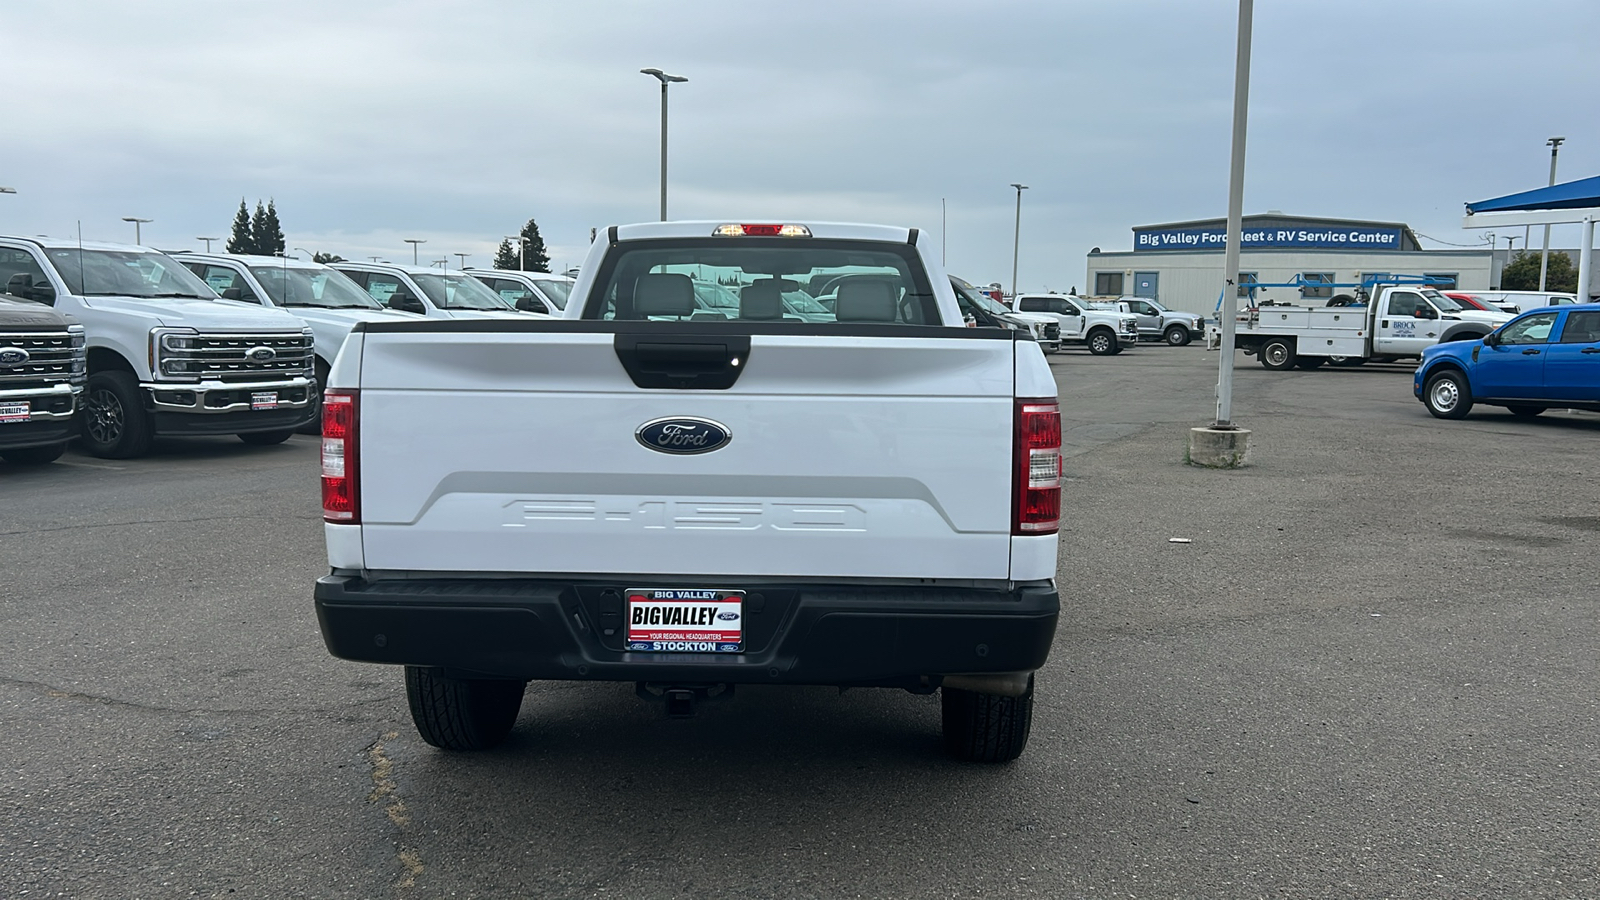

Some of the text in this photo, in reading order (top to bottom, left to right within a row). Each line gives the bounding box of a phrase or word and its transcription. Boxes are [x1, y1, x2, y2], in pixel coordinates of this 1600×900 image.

[1140, 234, 1159, 246] Big
[1162, 233, 1199, 245] Valley
[1240, 231, 1265, 242] leet
[1267, 233, 1275, 241] &
[1277, 231, 1296, 242] RV
[1298, 231, 1347, 242] Service
[1349, 232, 1395, 243] Center
[1393, 321, 1417, 329] BROCK
[657, 424, 708, 447] Ford
[502, 499, 867, 532] F-150
[654, 591, 716, 599] BIG VALLEY
[631, 607, 718, 625] BIGVALLEY
[653, 641, 716, 651] STOCKTON
